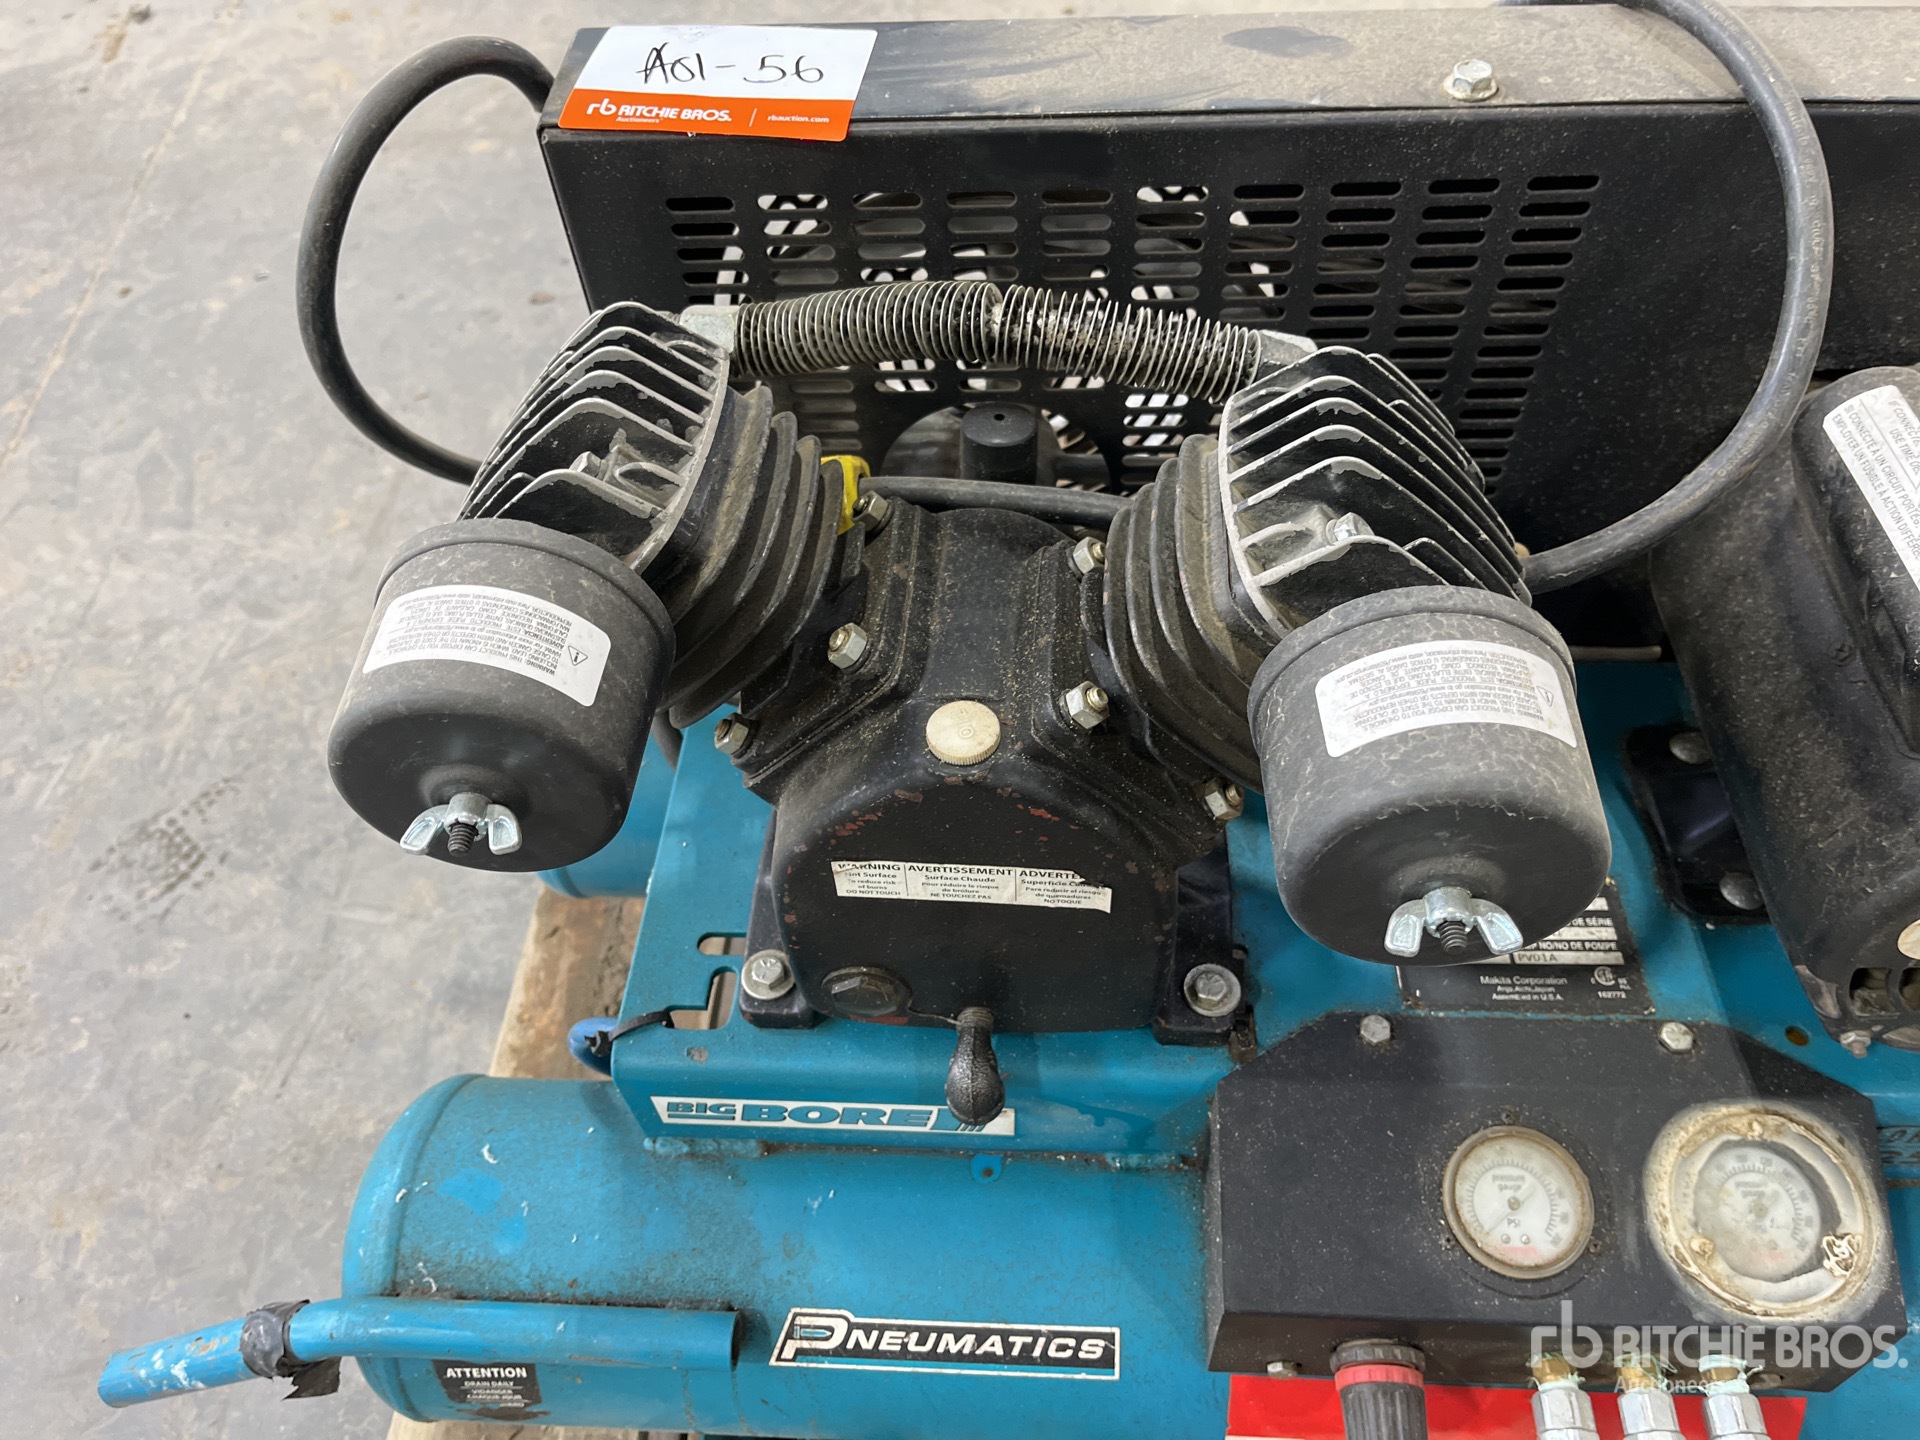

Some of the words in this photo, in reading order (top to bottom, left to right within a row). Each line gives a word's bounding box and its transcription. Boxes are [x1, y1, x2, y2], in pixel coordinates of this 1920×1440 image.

[618, 104, 680, 119] RITCHIE
[680, 109, 732, 122] BROS.
[767, 114, 830, 124] rbauction.com
[1881, 465, 1906, 494] CIRCUIT
[1860, 459, 1884, 491] FUSIBLE
[1881, 496, 1905, 525] ACTION
[908, 865, 1013, 876] AVERTISSEMENT
[1021, 879, 1067, 887] Superficie
[1480, 975, 1512, 985] Makita
[1513, 974, 1568, 986] Corporation
[667, 1101, 736, 1115] BIG
[741, 1104, 933, 1127] BORE
[781, 1315, 1105, 1360] PNEUMATICS
[446, 1366, 528, 1379] ATTENTION
